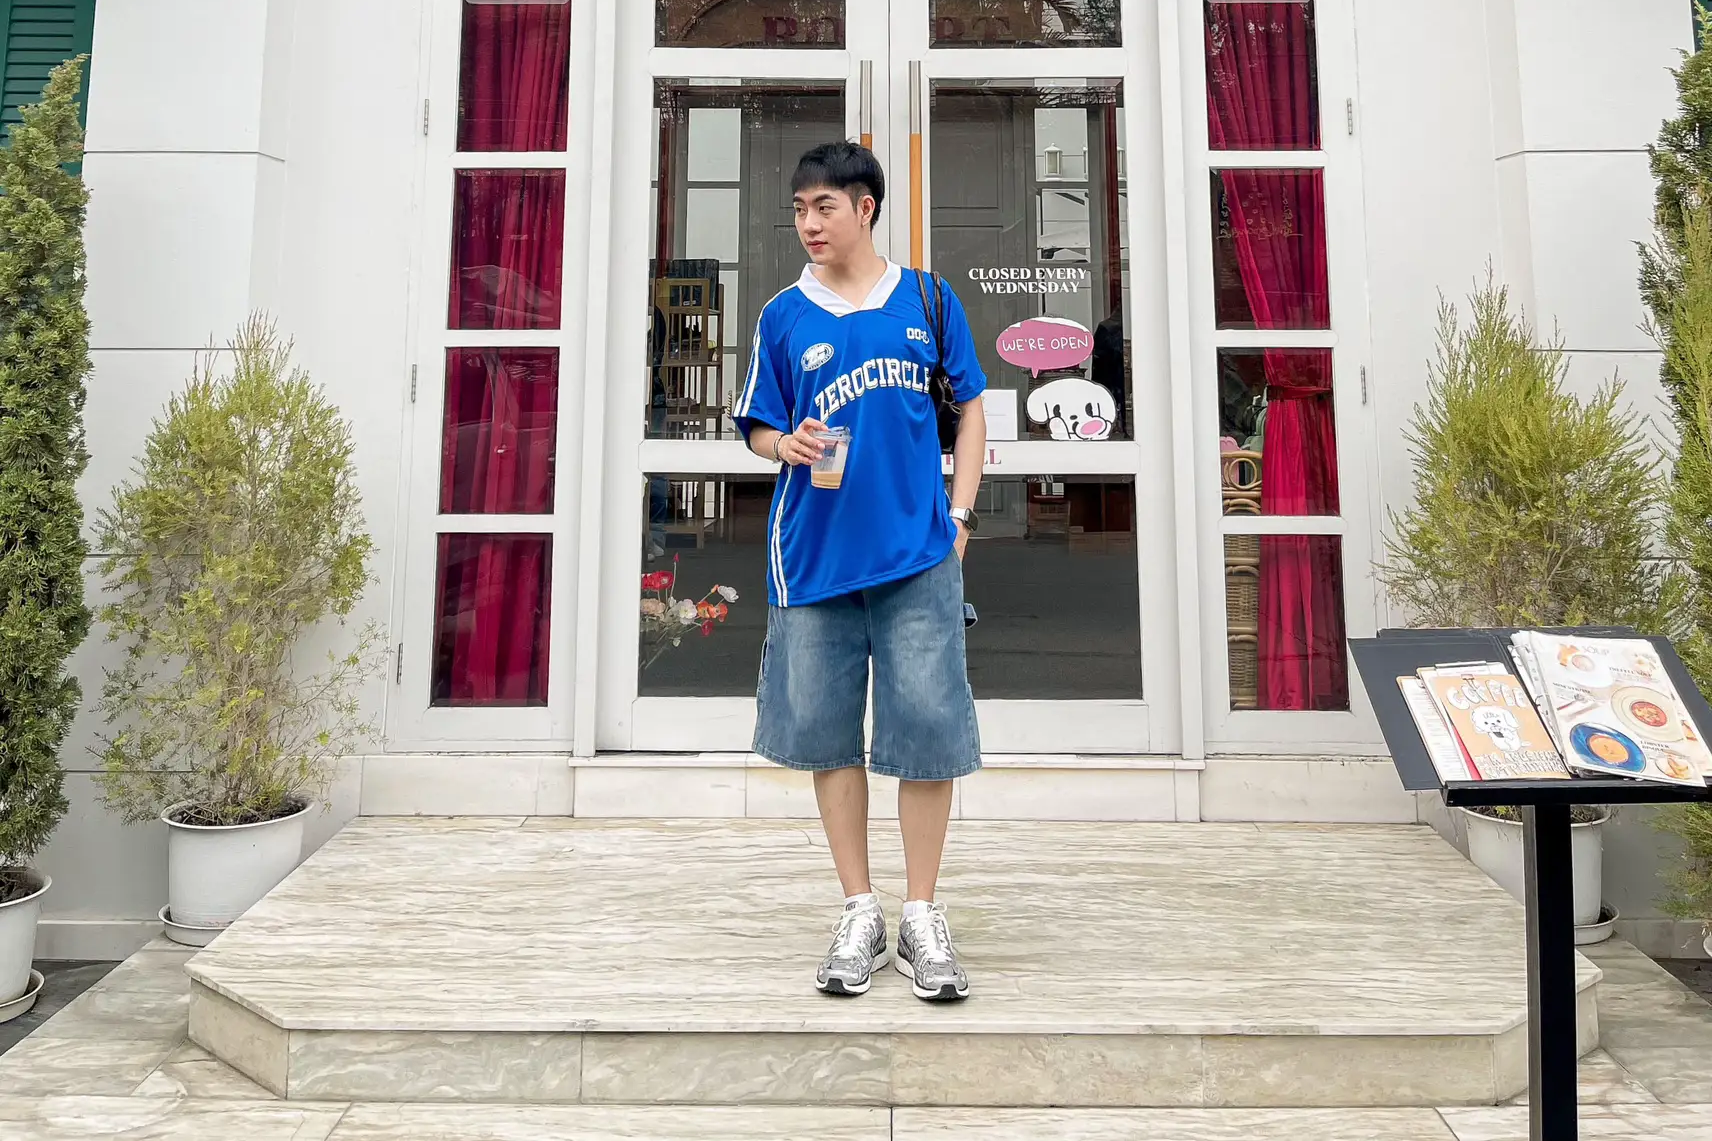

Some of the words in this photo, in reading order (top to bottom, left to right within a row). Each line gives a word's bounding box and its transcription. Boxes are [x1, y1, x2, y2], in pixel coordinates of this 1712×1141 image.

[968, 268, 1031, 280] CLOSED
[1035, 268, 1087, 280] EVERY
[980, 281, 1080, 294] WEDNESDAY
[1002, 338, 1046, 352] WE'RE
[1050, 335, 1089, 350] OPEN
